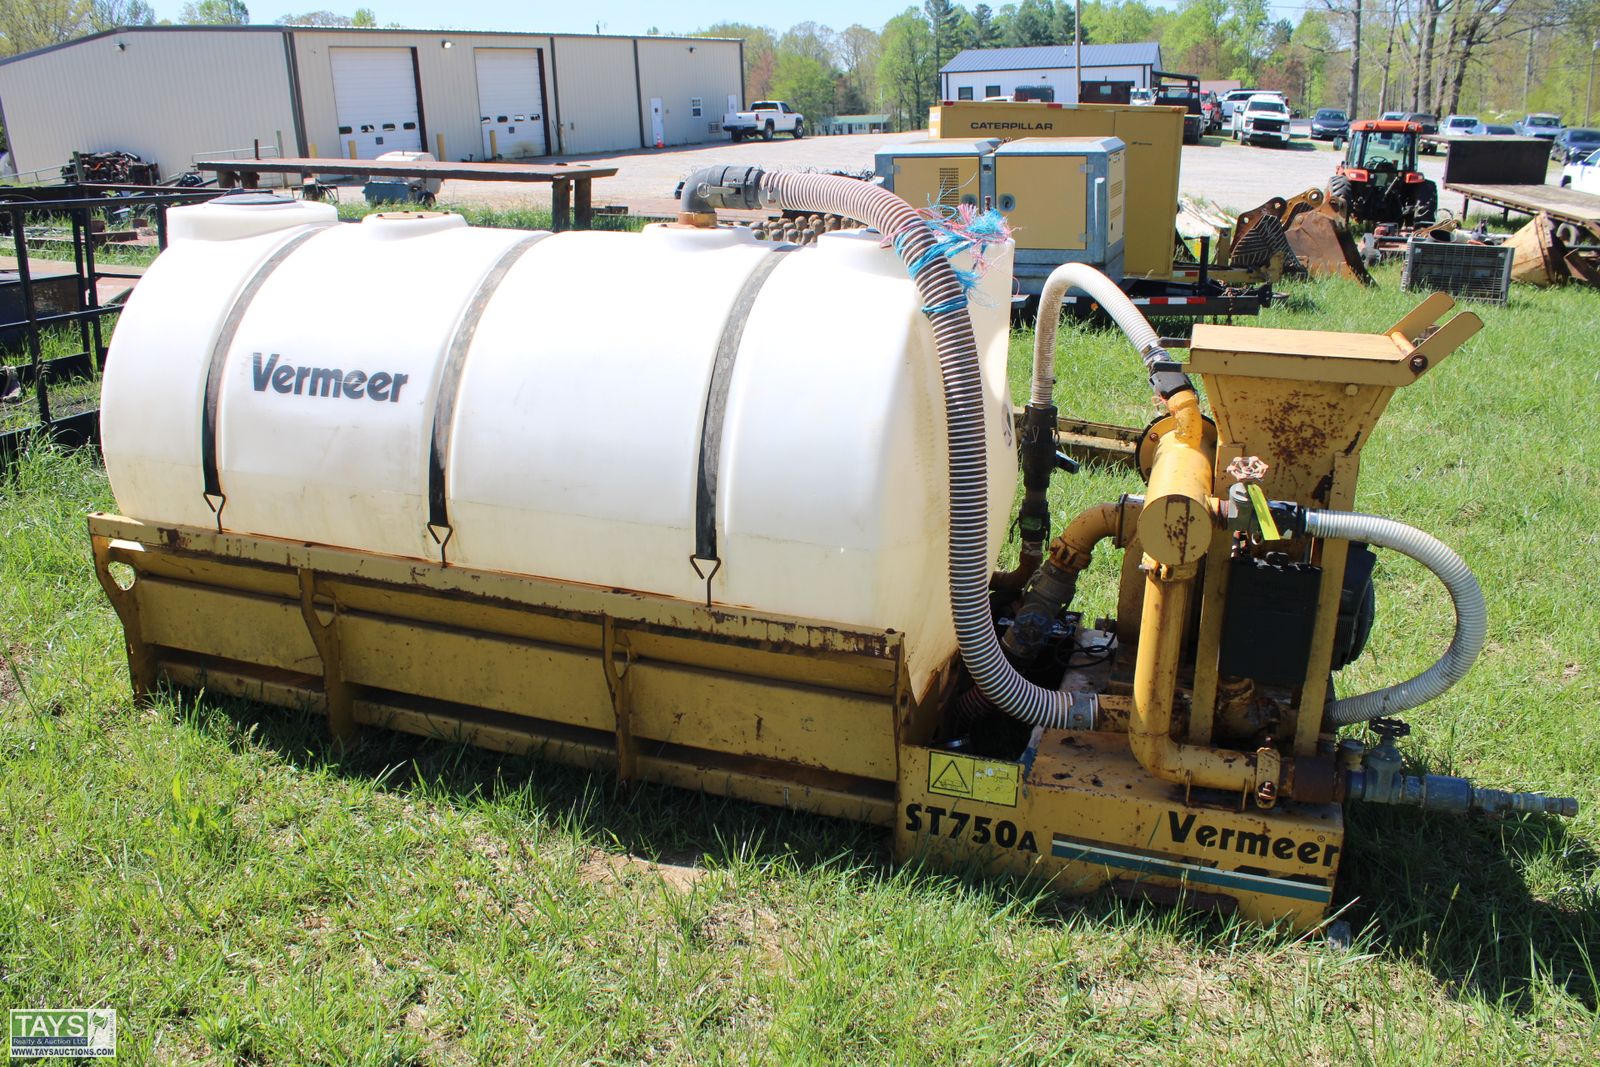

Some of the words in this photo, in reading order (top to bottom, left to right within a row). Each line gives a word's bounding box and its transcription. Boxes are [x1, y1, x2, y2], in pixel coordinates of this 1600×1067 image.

[970, 122, 1053, 130] CATERPILLAR
[253, 352, 408, 402] Vermeer
[905, 803, 1038, 853] ST750A
